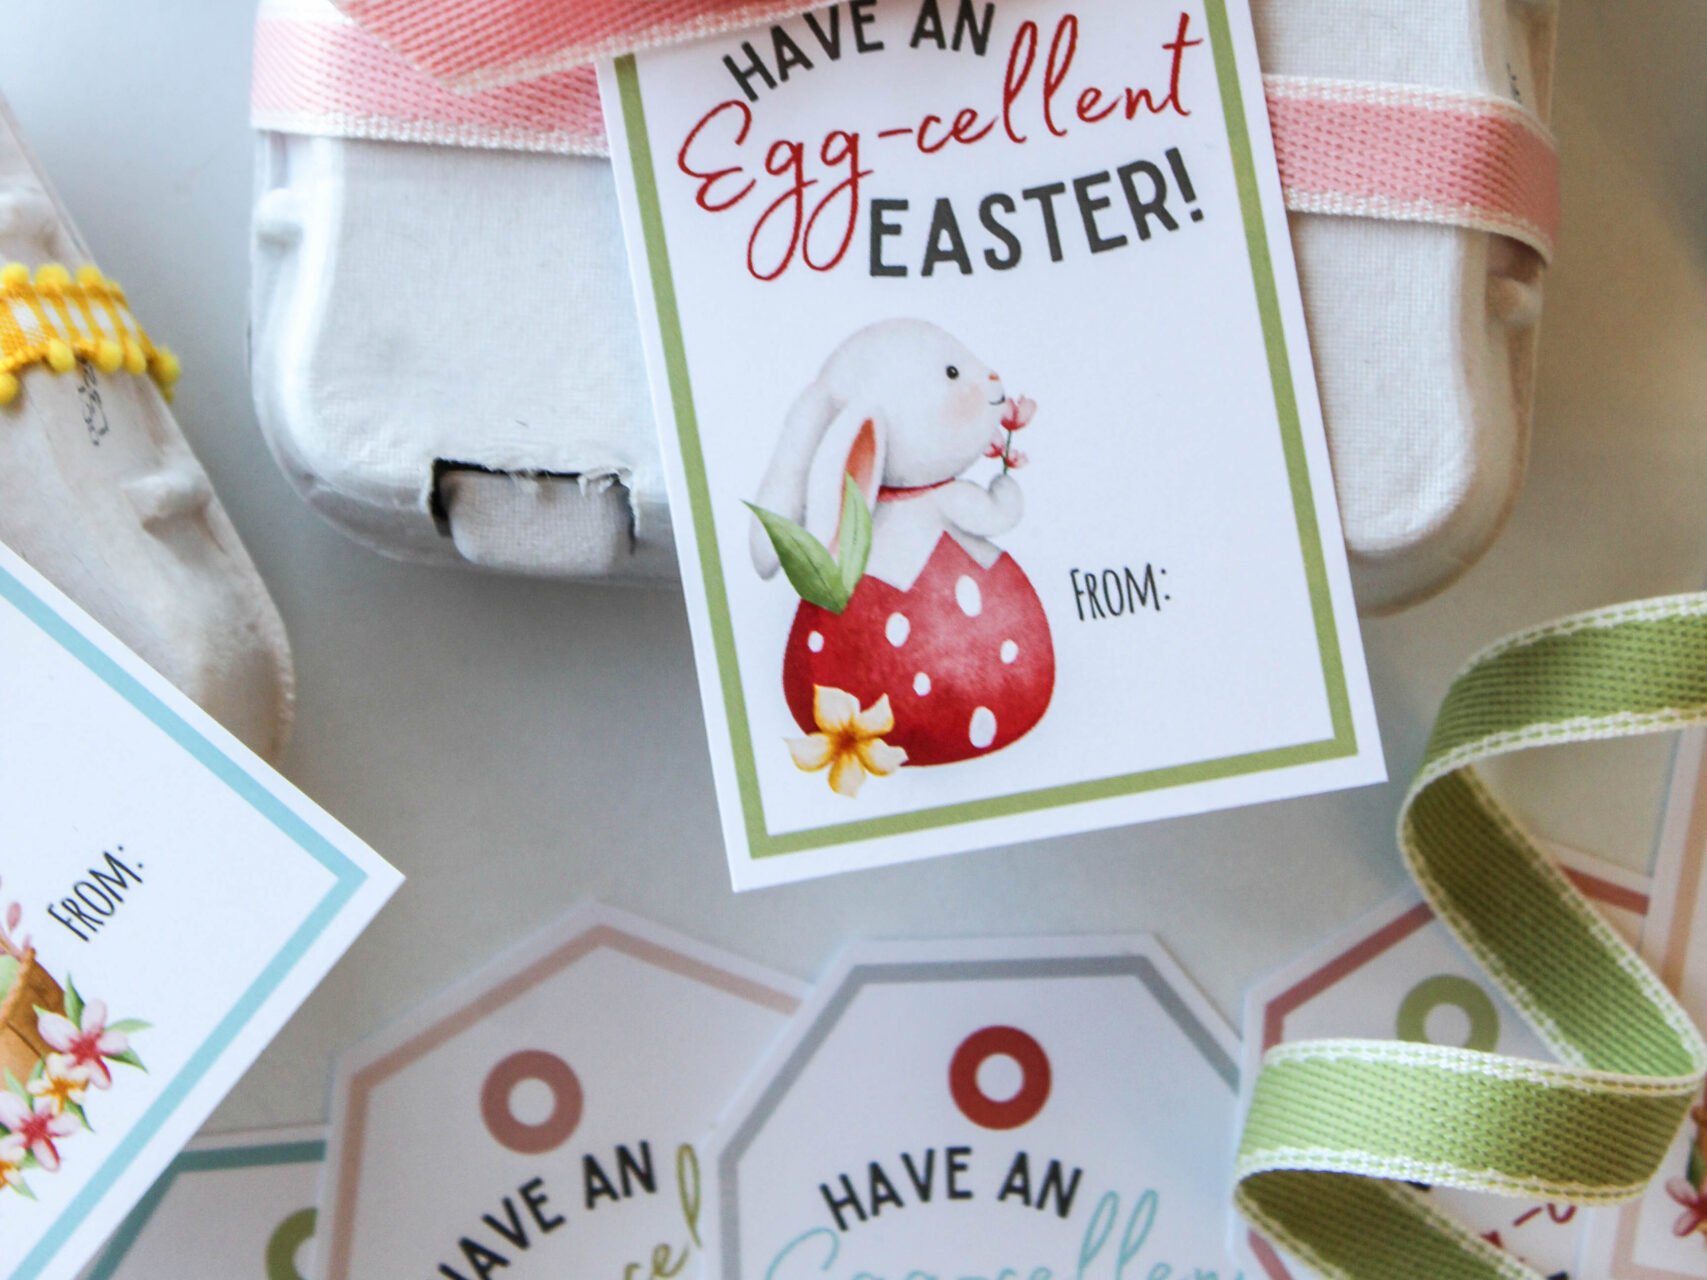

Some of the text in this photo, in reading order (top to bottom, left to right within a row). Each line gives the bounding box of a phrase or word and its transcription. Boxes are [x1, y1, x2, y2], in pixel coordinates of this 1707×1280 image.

[677, 11, 1204, 282] Egg-cellent
[868, 146, 1204, 277] EASTER!
[1069, 562, 1172, 621] FROM:
[46, 844, 145, 943] FROM:
[581, 1139, 658, 1210] AN
[818, 1146, 1083, 1232] HAVE AN
